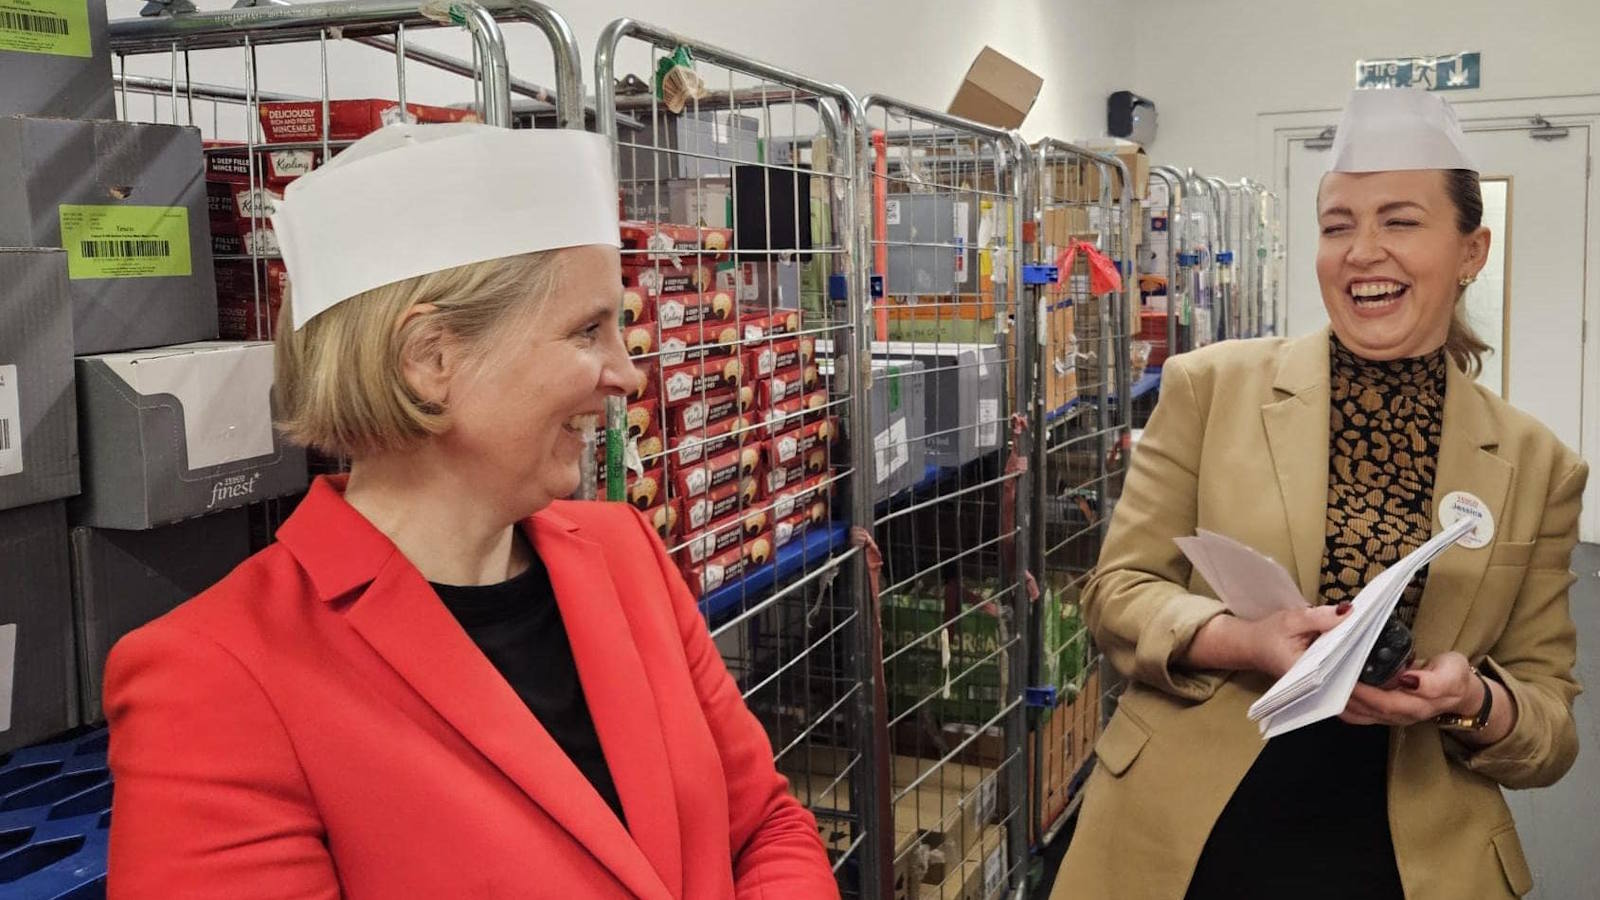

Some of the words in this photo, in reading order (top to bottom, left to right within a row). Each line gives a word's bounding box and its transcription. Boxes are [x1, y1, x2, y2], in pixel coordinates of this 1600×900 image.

[1363, 63, 1398, 76] Fire
[269, 109, 315, 119] DELICIOUSLY
[272, 124, 316, 133] MINCEMEAT
[233, 158, 250, 166] FILLE
[277, 157, 309, 171] Kipling
[206, 477, 255, 508] finest
